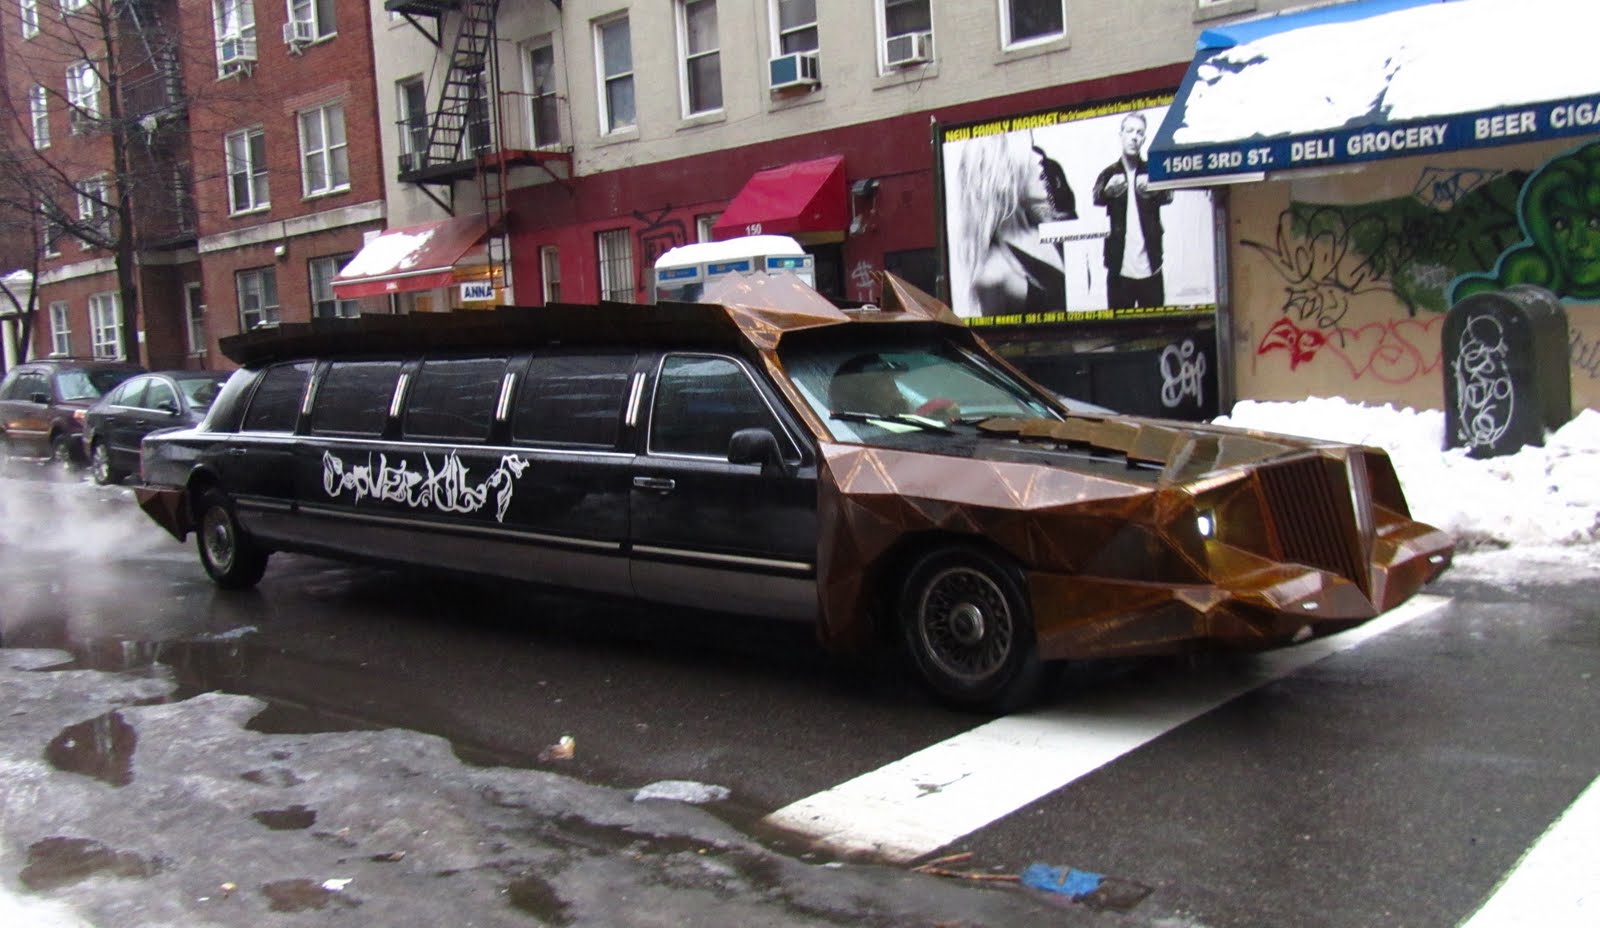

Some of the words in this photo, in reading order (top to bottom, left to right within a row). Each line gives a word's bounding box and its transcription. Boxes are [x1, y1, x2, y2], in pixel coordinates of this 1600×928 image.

[945, 127, 970, 142] NEW
[972, 120, 1010, 138] FAMILY
[1012, 112, 1058, 132] MARKET
[1208, 152, 1242, 169] 3RD
[1247, 147, 1274, 165] ST.
[1290, 138, 1335, 162] DELI
[1346, 123, 1449, 155] GROCERY
[1474, 111, 1537, 140] BEER
[745, 223, 762, 236] 150
[464, 286, 493, 298] ANNA
